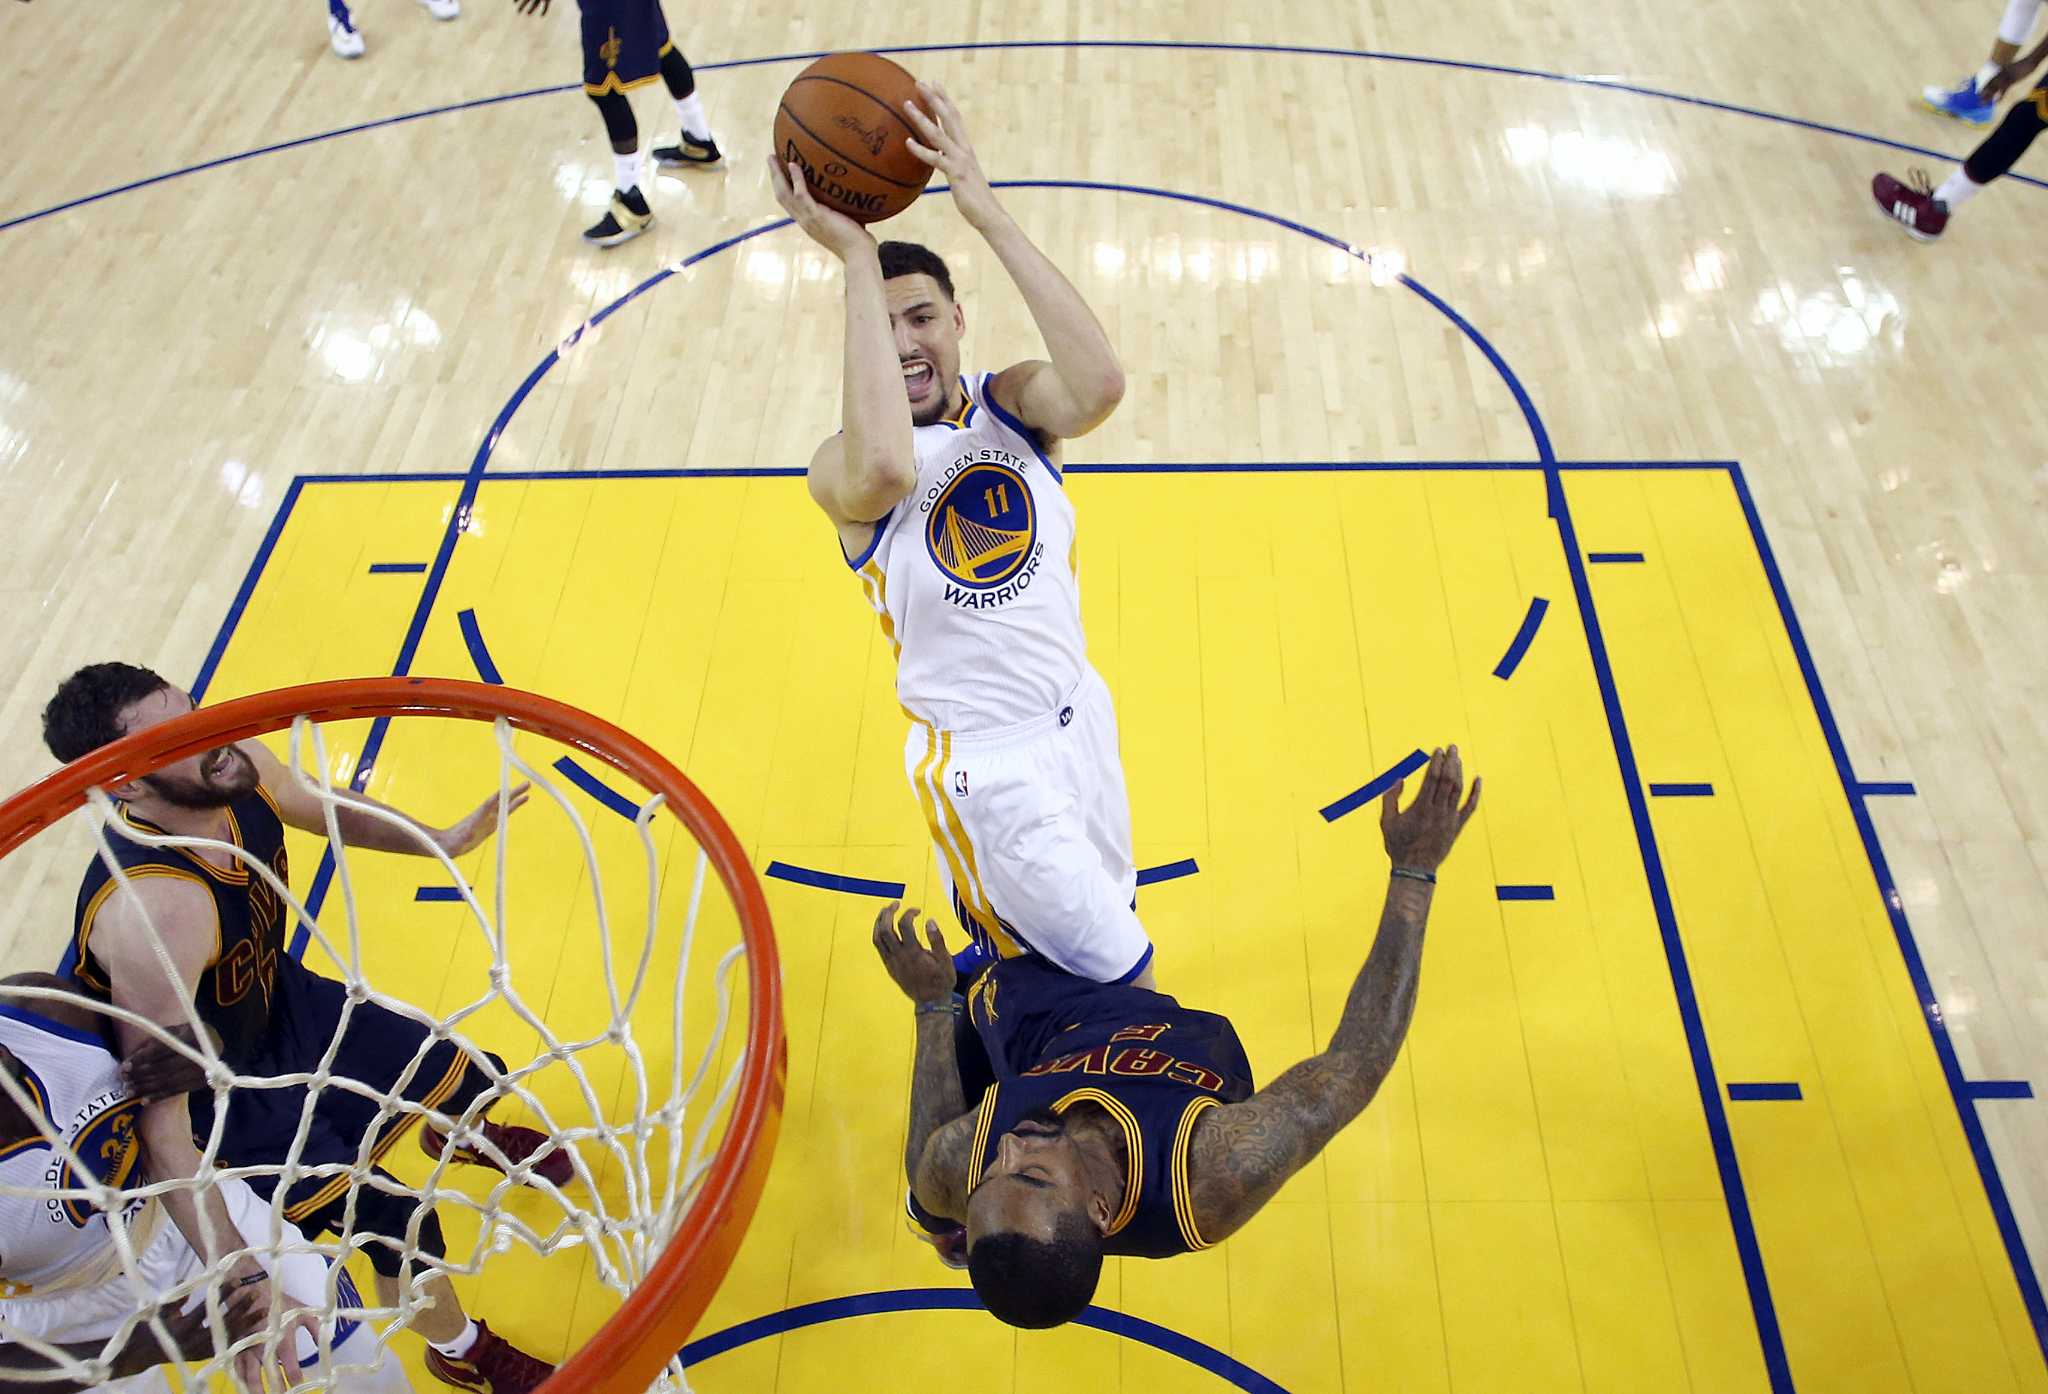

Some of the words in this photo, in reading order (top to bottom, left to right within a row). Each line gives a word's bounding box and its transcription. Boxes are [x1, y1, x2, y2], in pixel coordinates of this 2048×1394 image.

[783, 138, 889, 212] ALDING
[919, 451, 975, 513] GOLDEN
[979, 449, 1029, 475] STATE
[983, 482, 1010, 519] 11
[943, 541, 1045, 610] WARRIORS
[45, 1152, 66, 1224] GODE
